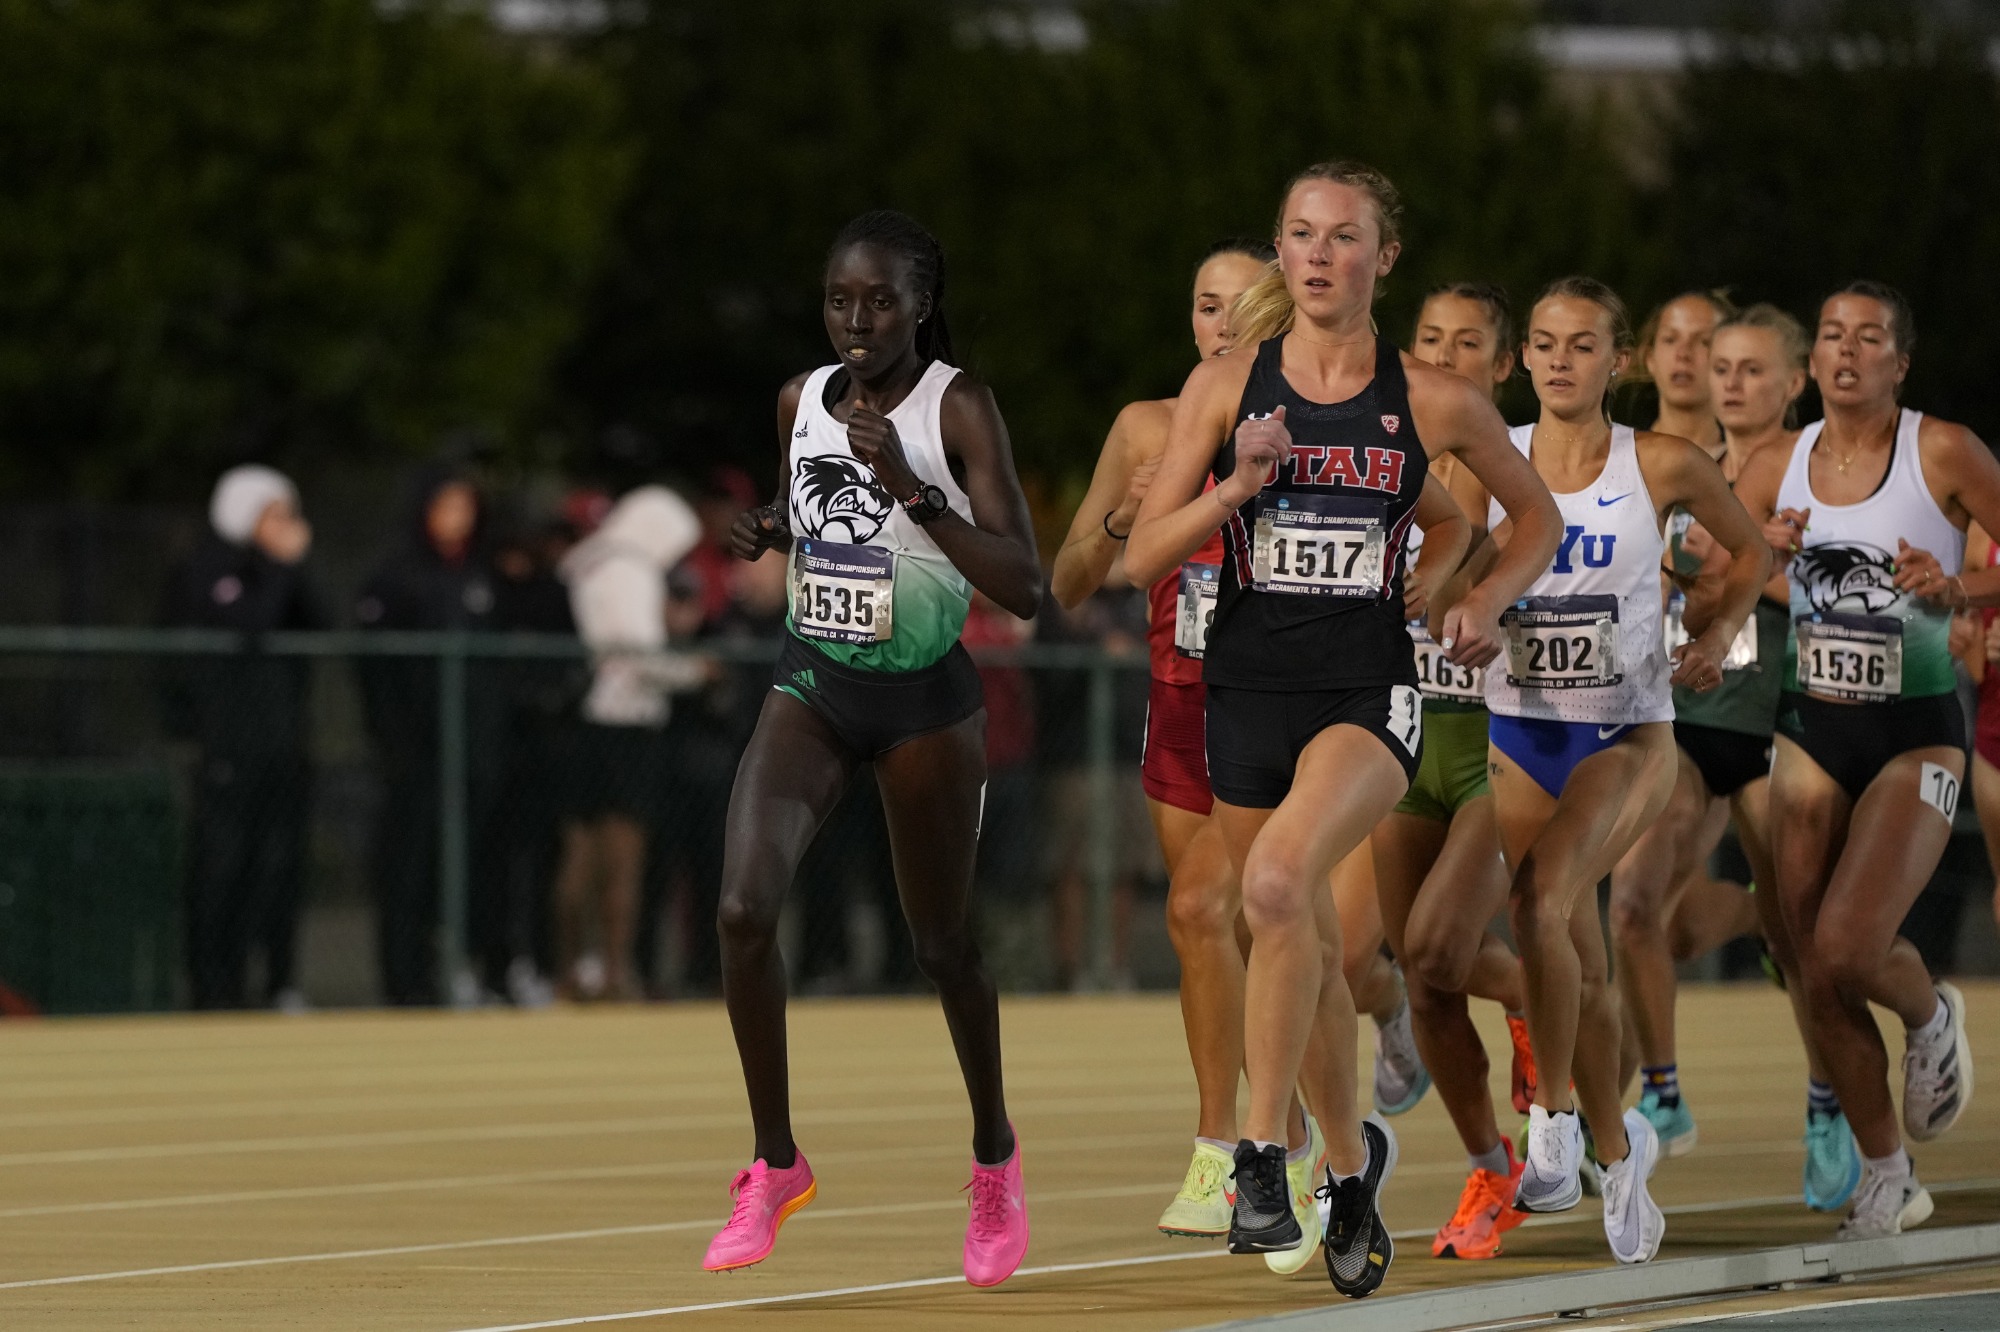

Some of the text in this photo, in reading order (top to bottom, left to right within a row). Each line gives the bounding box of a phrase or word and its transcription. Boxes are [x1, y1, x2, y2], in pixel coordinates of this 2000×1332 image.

[1381, 415, 1399, 428] PAC
[1386, 424, 1397, 433] 12
[1263, 445, 1405, 494] TAH
[1276, 513, 1298, 522] TRACK
[1304, 515, 1322, 524] FIELD
[1323, 516, 1380, 525] CHAMPIONSHIPS
[1273, 538, 1365, 579] 1517
[1553, 525, 1617, 574] YU
[820, 562, 835, 570] FIELD
[835, 563, 886, 575] CHAMPIONSHIPS
[1267, 583, 1310, 594] SACRAMENTO,
[1311, 586, 1320, 594] CA
[1332, 588, 1347, 596] MAY
[803, 582, 874, 627] 1535
[1542, 614, 1558, 623] FIELD
[1559, 611, 1612, 622] CHAMPIONSHIPS
[829, 631, 837, 639] CA
[1526, 636, 1594, 672] 202
[1812, 648, 1885, 686] 1536
[1933, 771, 1956, 816] 10
